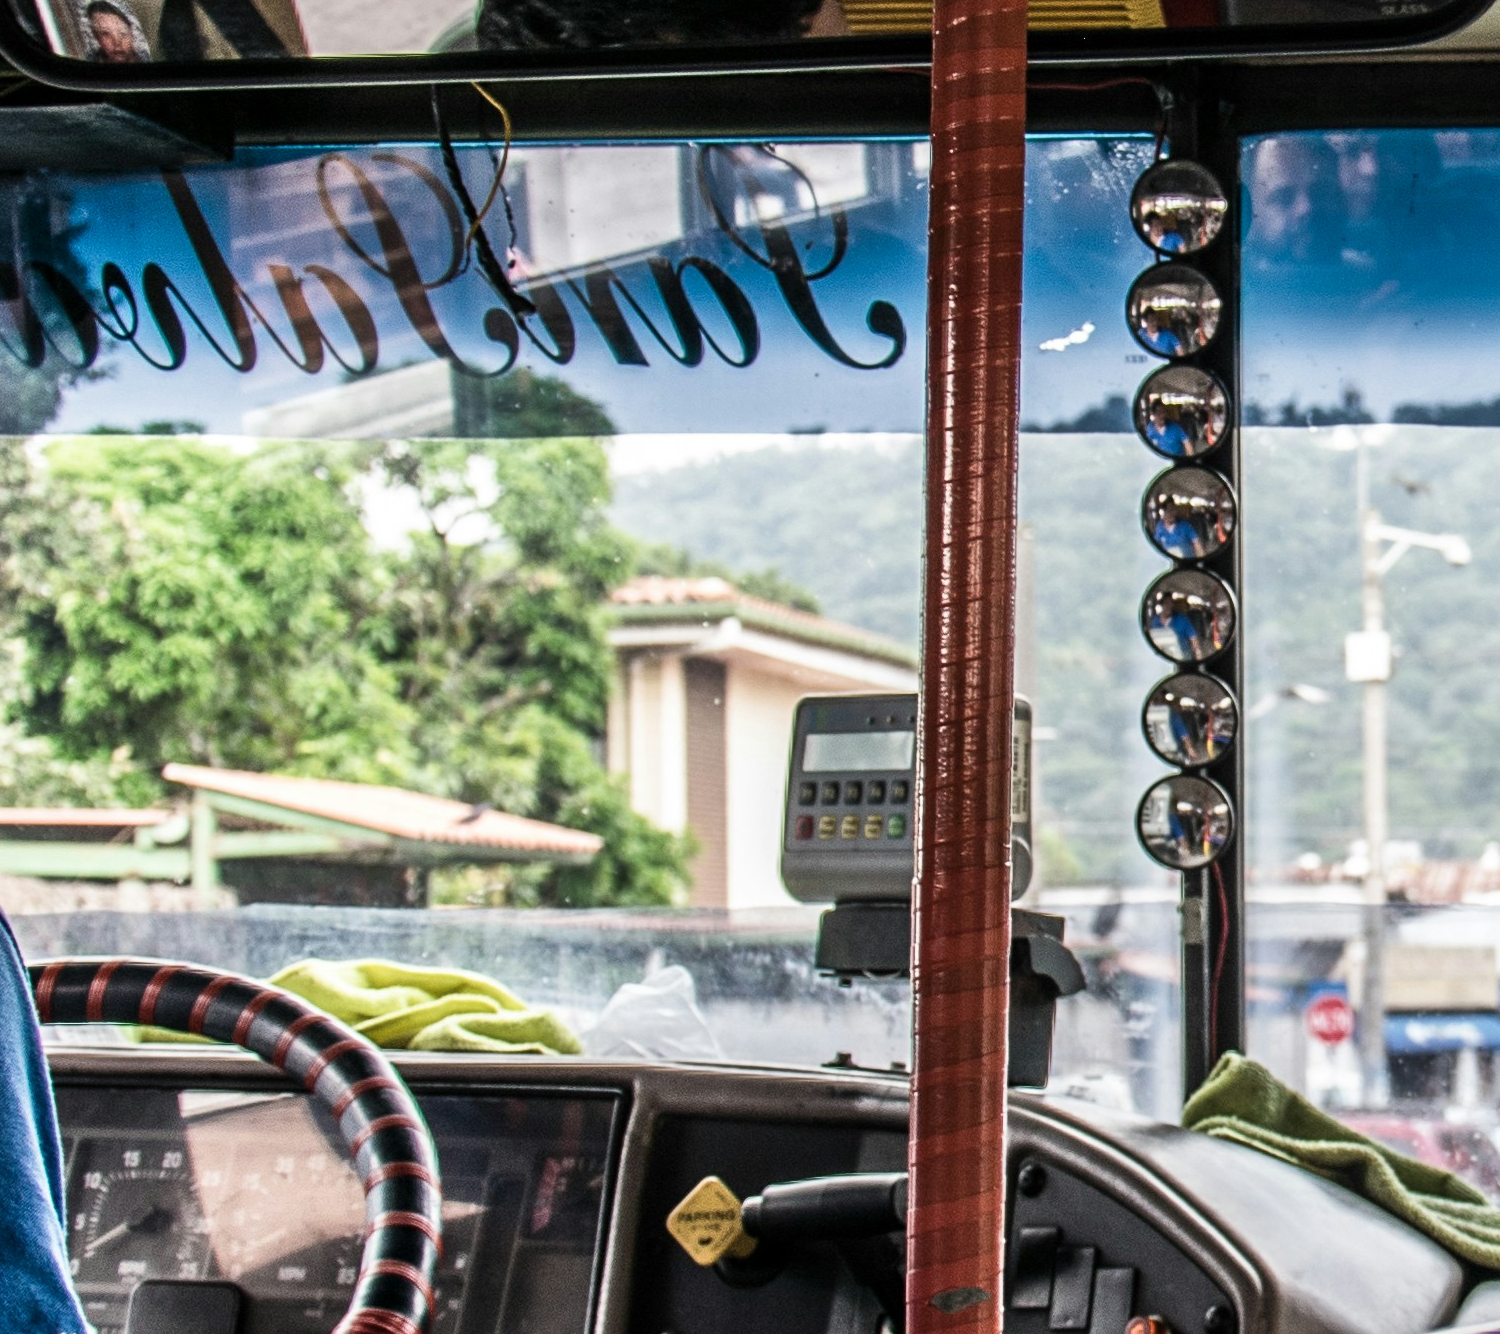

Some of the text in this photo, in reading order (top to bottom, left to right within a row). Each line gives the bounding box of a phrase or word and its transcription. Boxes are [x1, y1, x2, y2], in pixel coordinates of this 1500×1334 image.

[122, 1151, 183, 1168] 15 20
[83, 1172, 102, 1189] 10
[677, 1209, 736, 1223] PARKING
